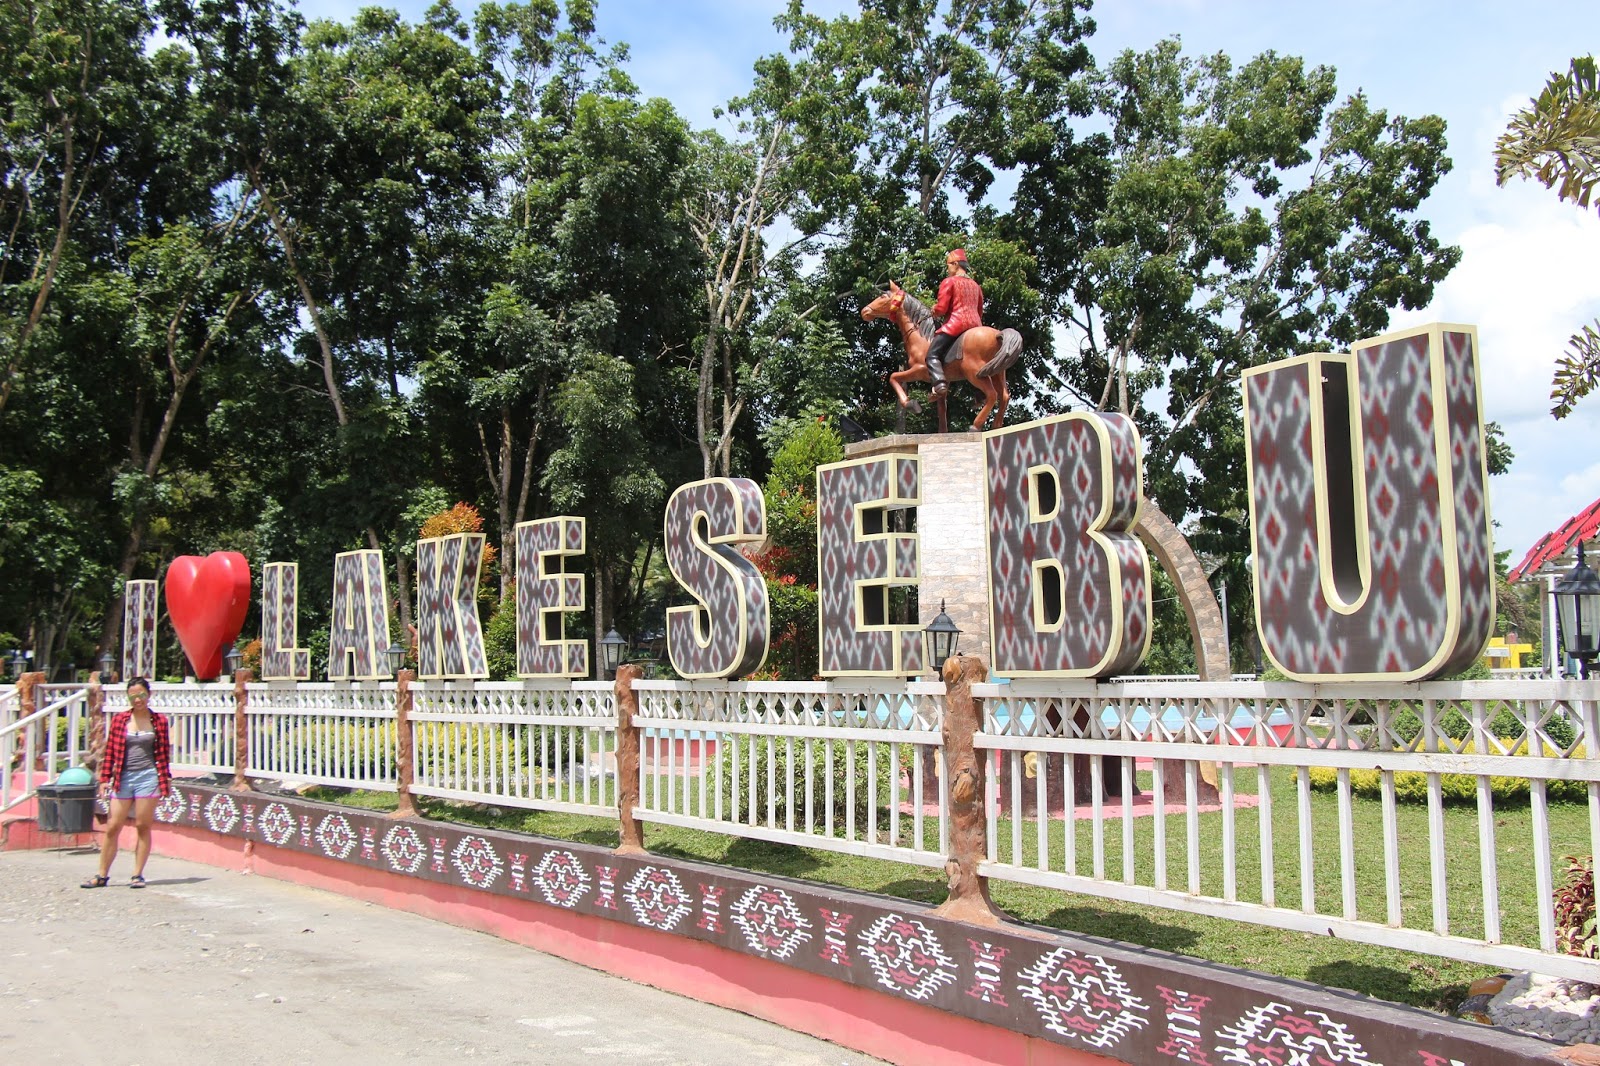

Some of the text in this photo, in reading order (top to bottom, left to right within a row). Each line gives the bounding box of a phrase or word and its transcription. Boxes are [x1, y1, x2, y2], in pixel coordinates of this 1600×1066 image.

[123, 322, 1497, 683] I LAKE SEBU
